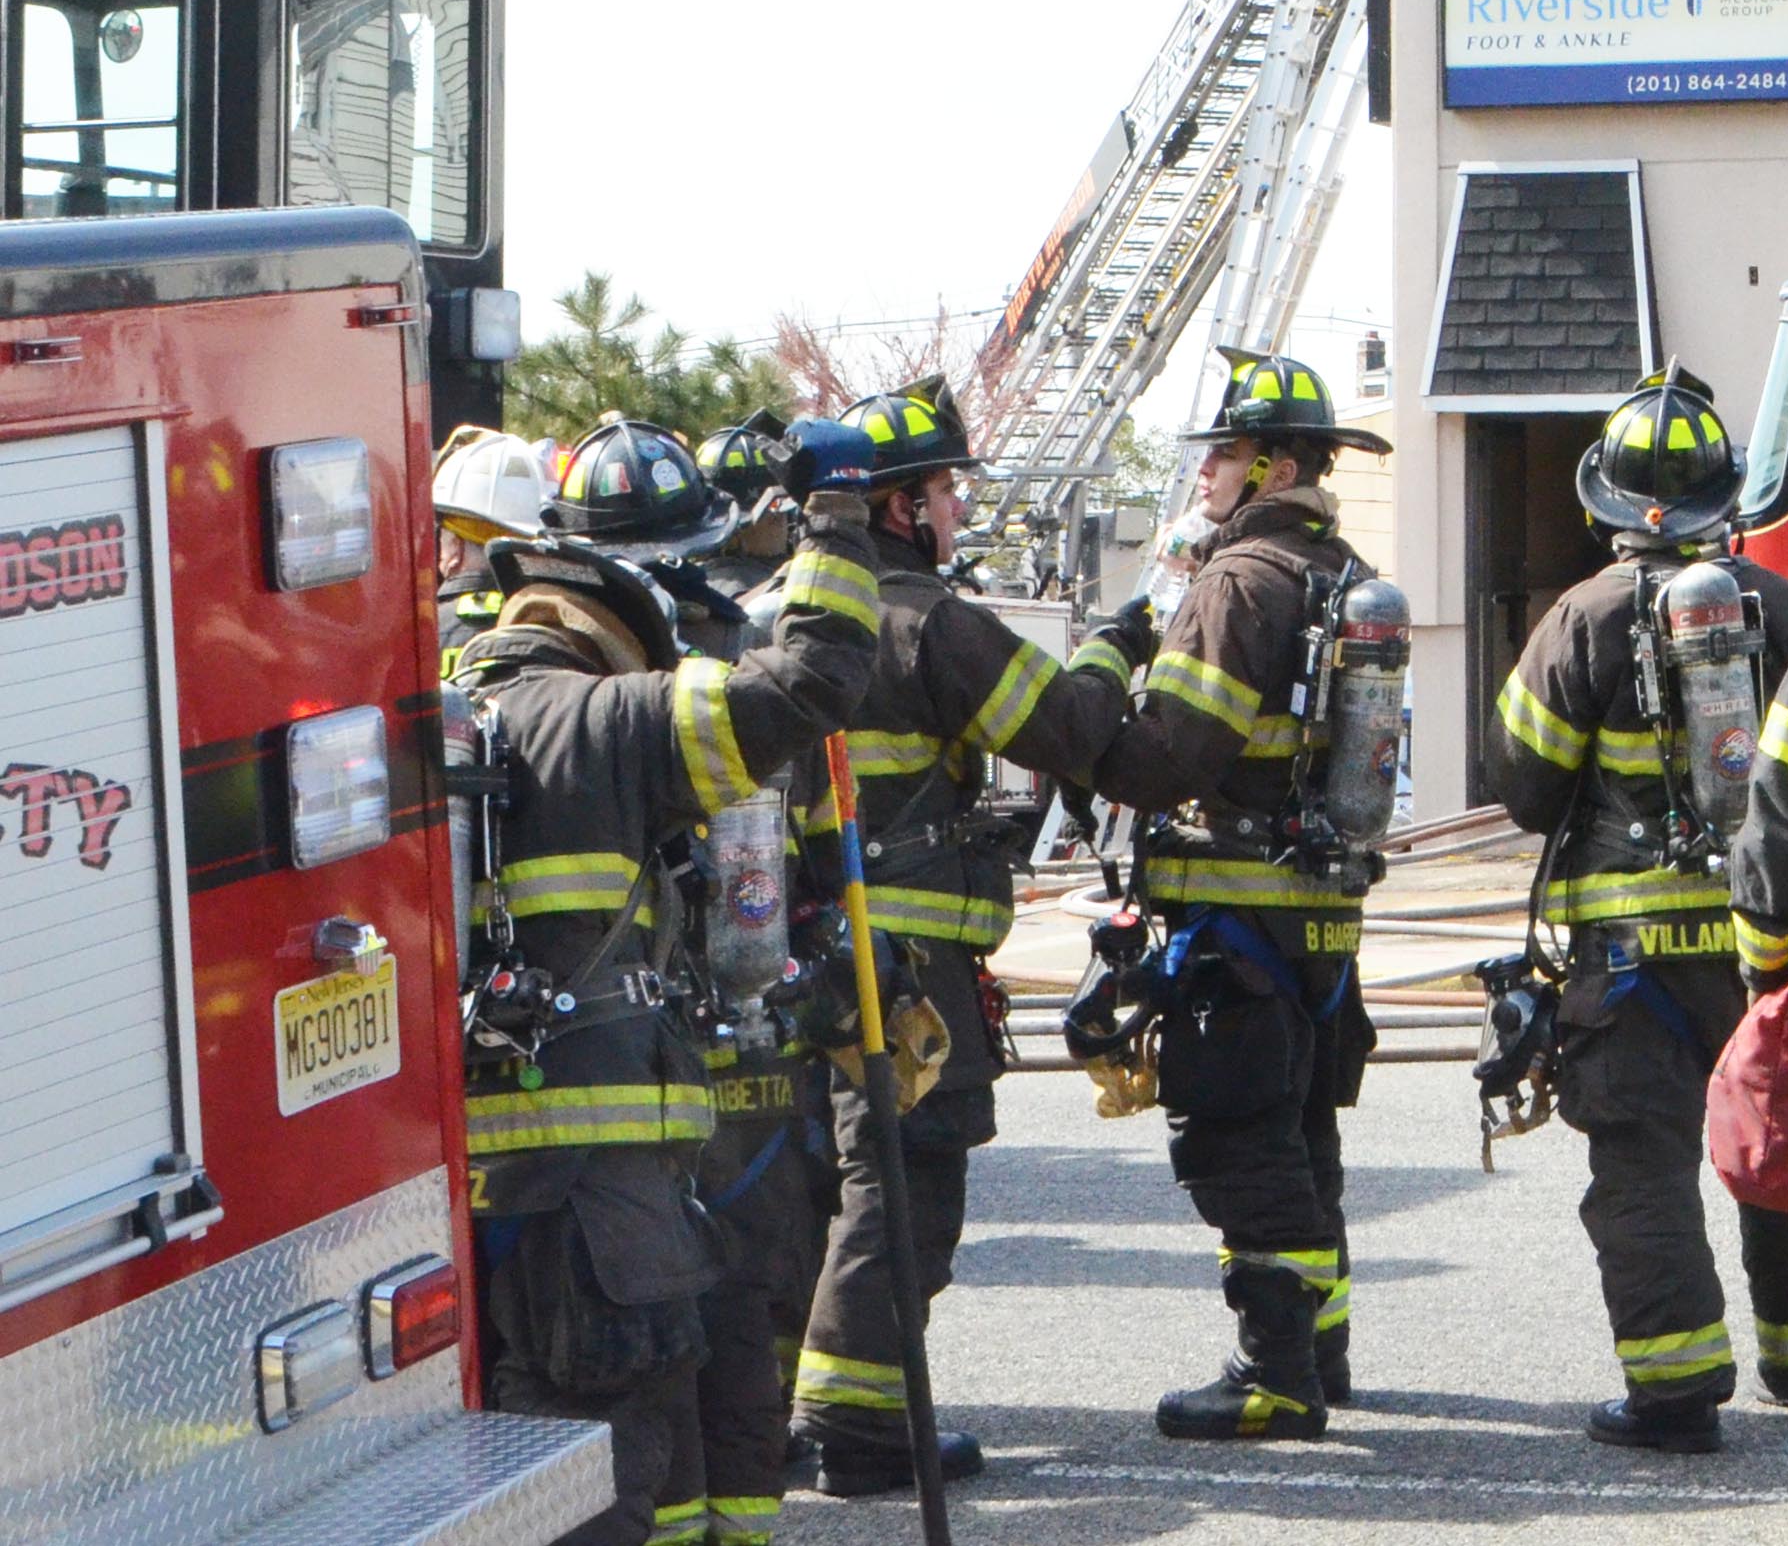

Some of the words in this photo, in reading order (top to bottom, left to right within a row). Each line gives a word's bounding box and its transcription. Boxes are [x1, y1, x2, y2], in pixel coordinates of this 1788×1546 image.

[1720, 5, 1774, 17] GROUP
[1466, 34, 1525, 51] FOOT
[1534, 33, 1547, 49] &
[1559, 31, 1632, 48] ANKLE
[1627, 74, 1680, 95] (201)
[1687, 72, 1788, 91] 864-2484
[1006, 252, 1046, 339] NORTH
[1044, 168, 1096, 260] HUDSON
[285, 988, 391, 1080] MG90381
[312, 1063, 372, 1095] MUNICIPAL
